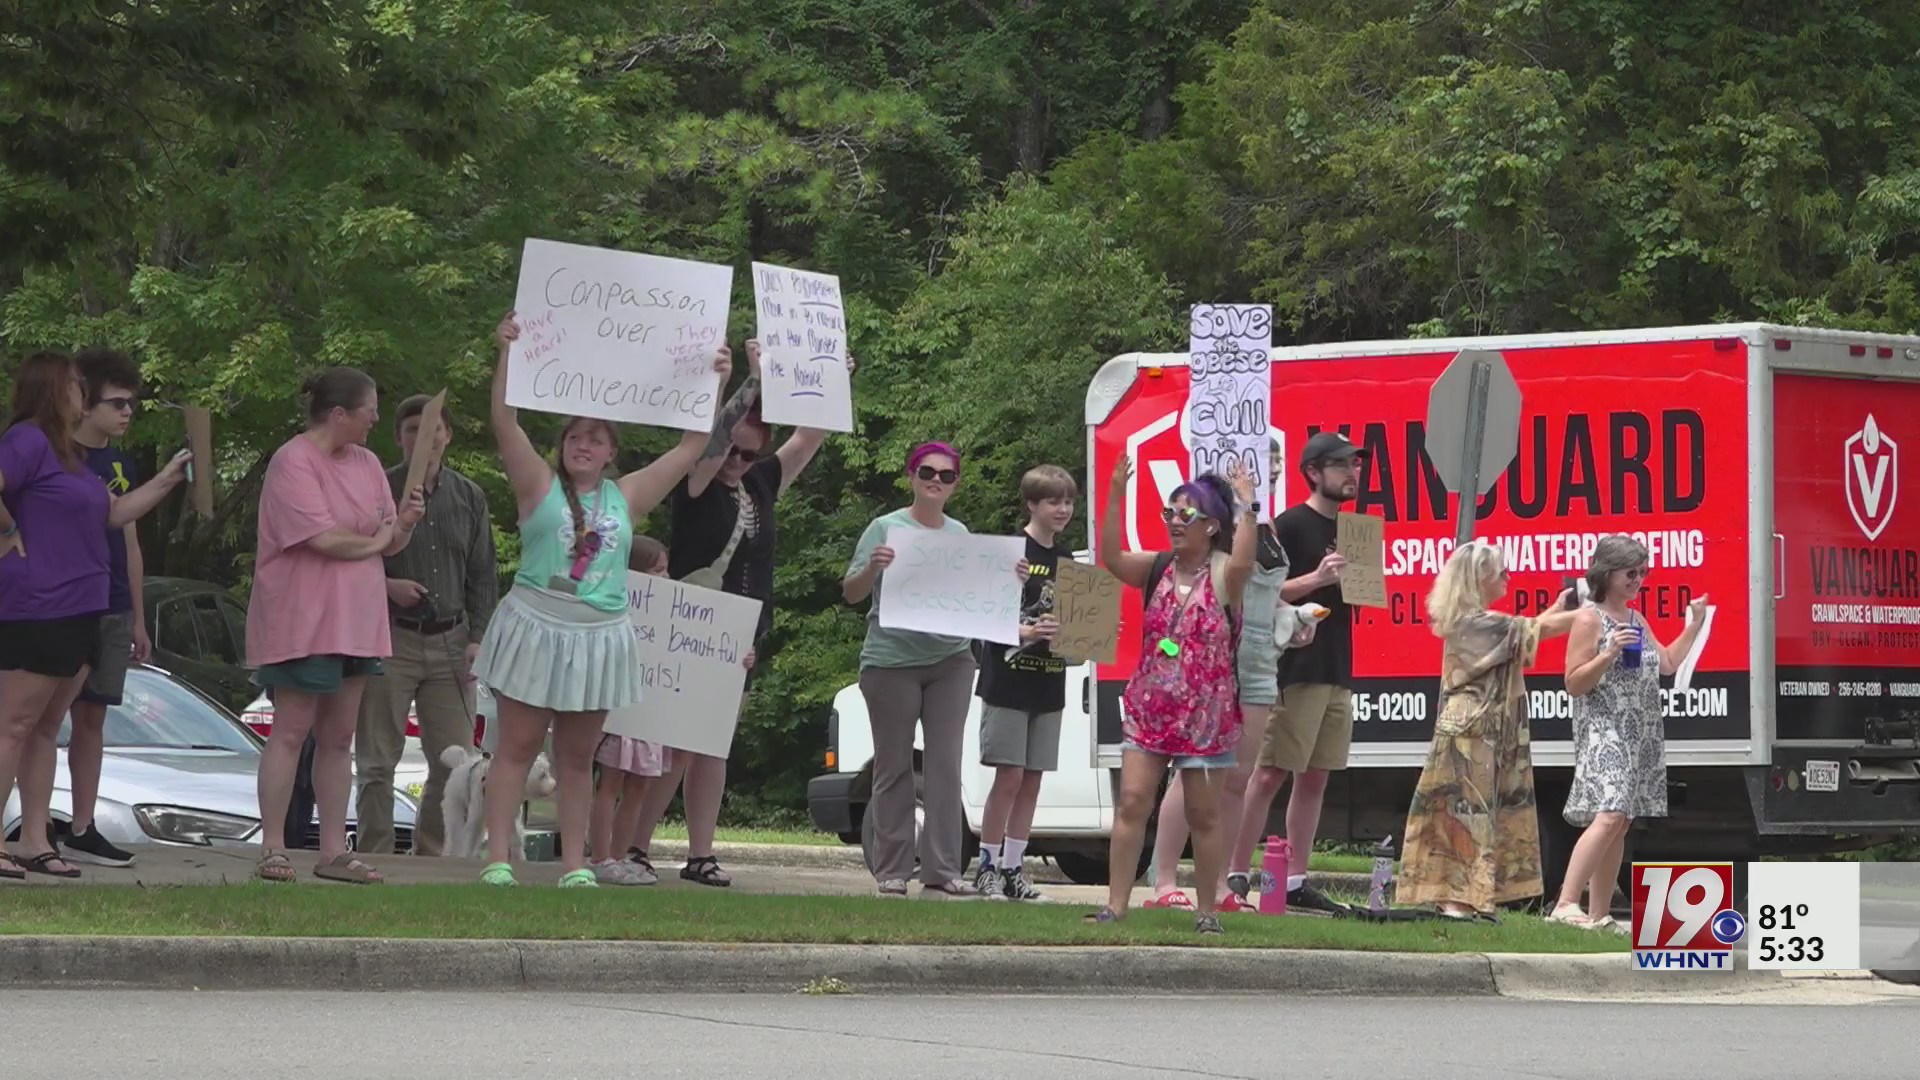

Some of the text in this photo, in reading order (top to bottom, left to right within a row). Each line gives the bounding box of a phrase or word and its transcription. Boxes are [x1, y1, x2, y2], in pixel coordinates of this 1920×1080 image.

[1190, 349, 1269, 381] geese
[1194, 447, 1262, 487] HOA
[1307, 408, 1705, 521] ANUARD
[670, 586, 714, 624] Harm
[1812, 604, 1864, 623] CRAWLSPACE
[667, 623, 738, 664] beautiful
[1780, 682, 1807, 695] VETERAN
[1808, 682, 1830, 696] OWNED
[1838, 682, 1882, 697] 256-245-0200
